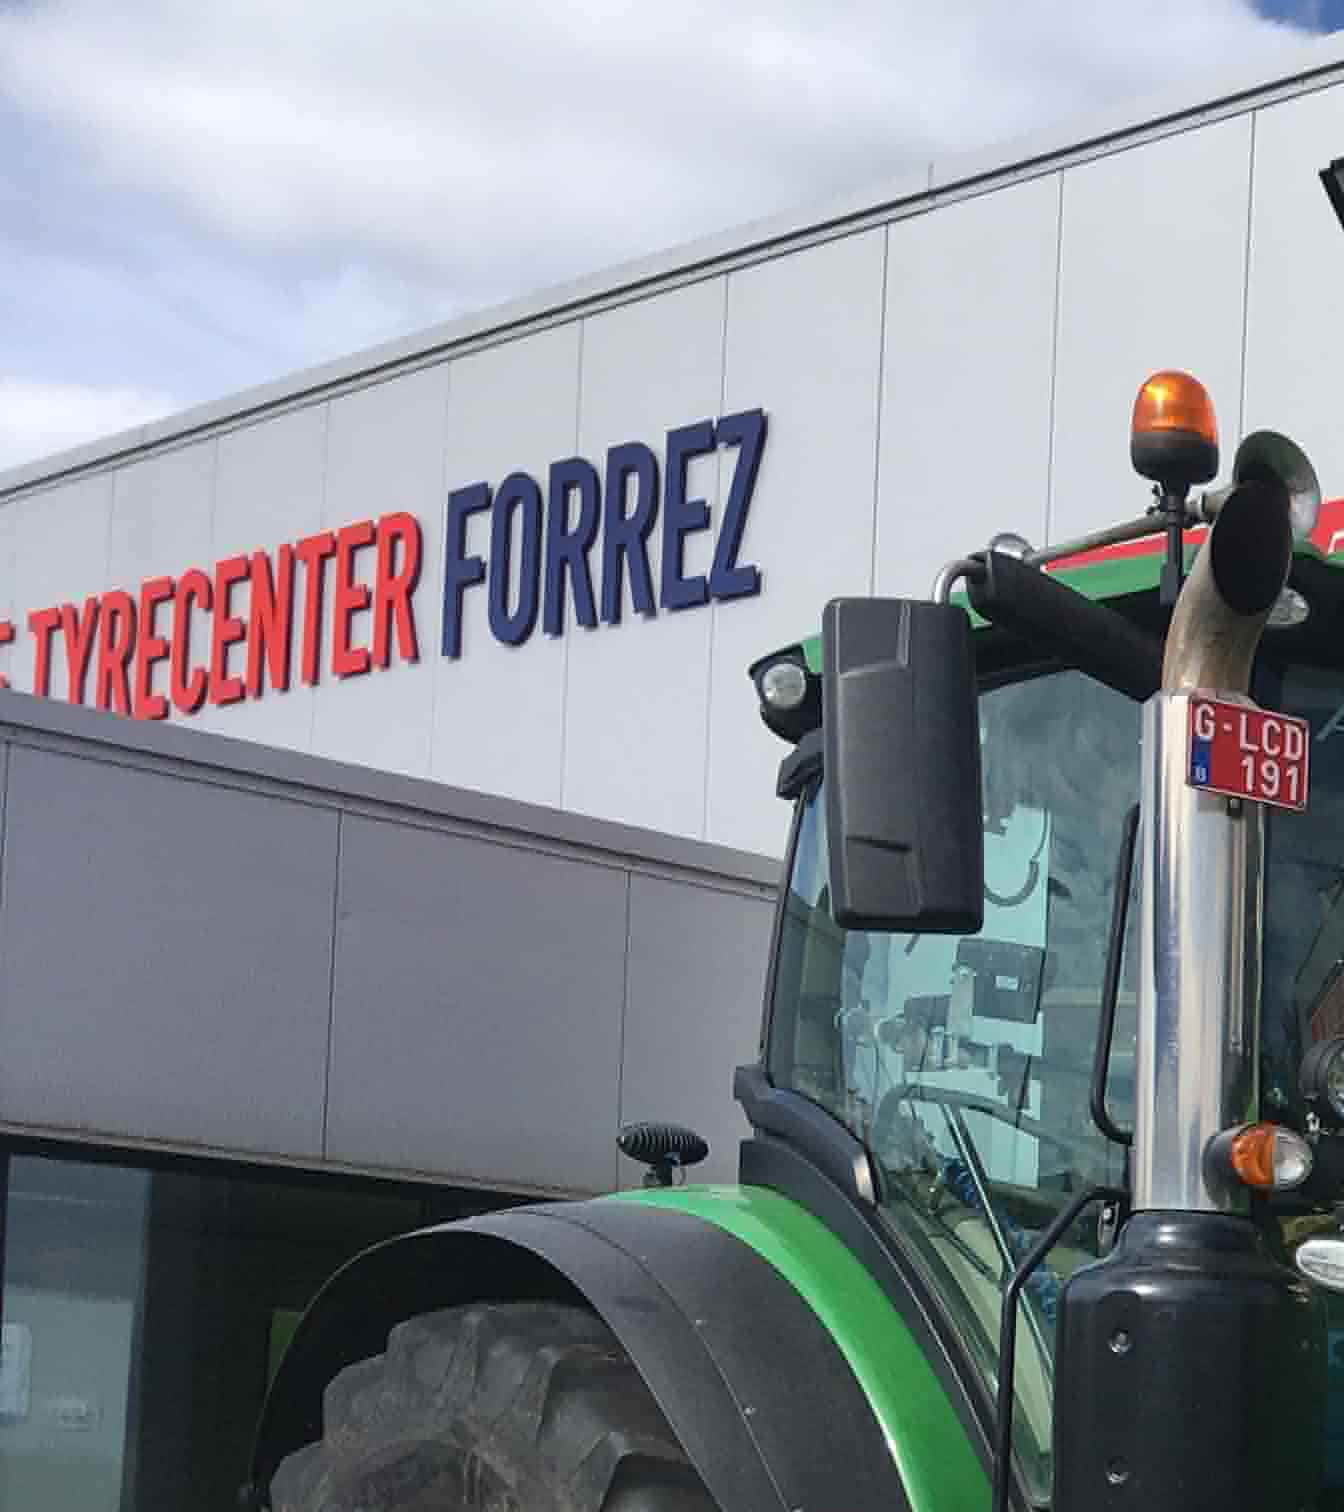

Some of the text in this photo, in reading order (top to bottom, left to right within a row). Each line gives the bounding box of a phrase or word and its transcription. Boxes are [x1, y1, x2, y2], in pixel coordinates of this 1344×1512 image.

[28, 407, 769, 720] TYRECENTER FORREZ
[1193, 703, 1303, 761] G-LCD
[1240, 756, 1299, 801] 191
